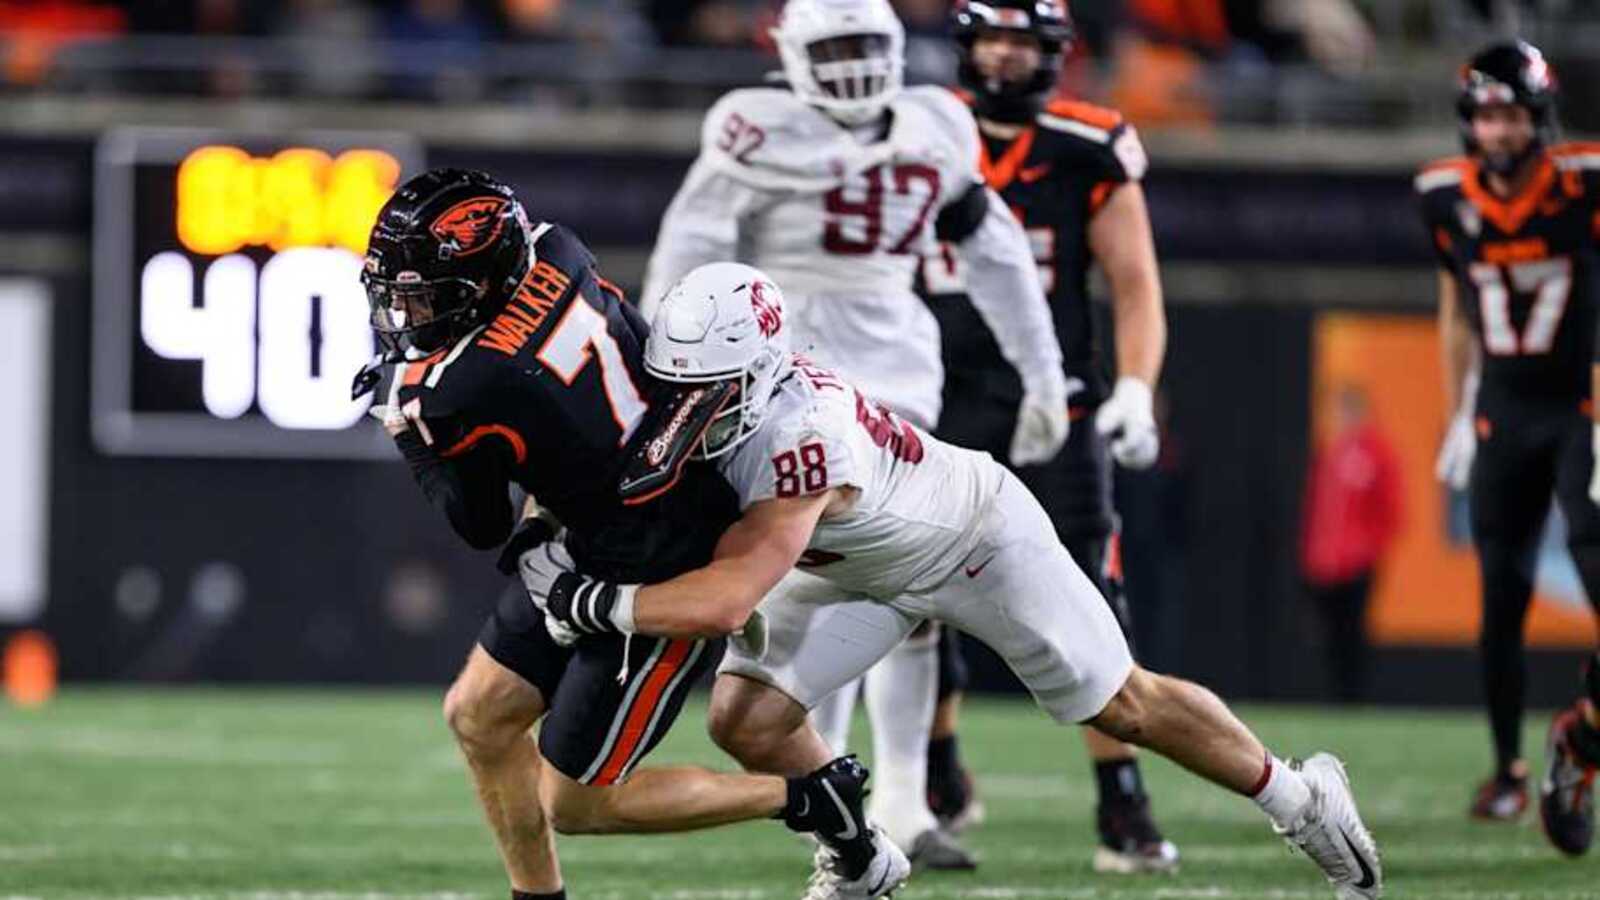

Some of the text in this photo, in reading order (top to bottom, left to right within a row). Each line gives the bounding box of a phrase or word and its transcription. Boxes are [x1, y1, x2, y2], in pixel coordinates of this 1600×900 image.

[140, 247, 375, 430] 40
[476, 260, 571, 358] WALKER
[1468, 256, 1571, 355] 17
[534, 293, 649, 449] 7
[772, 442, 828, 498] 88
